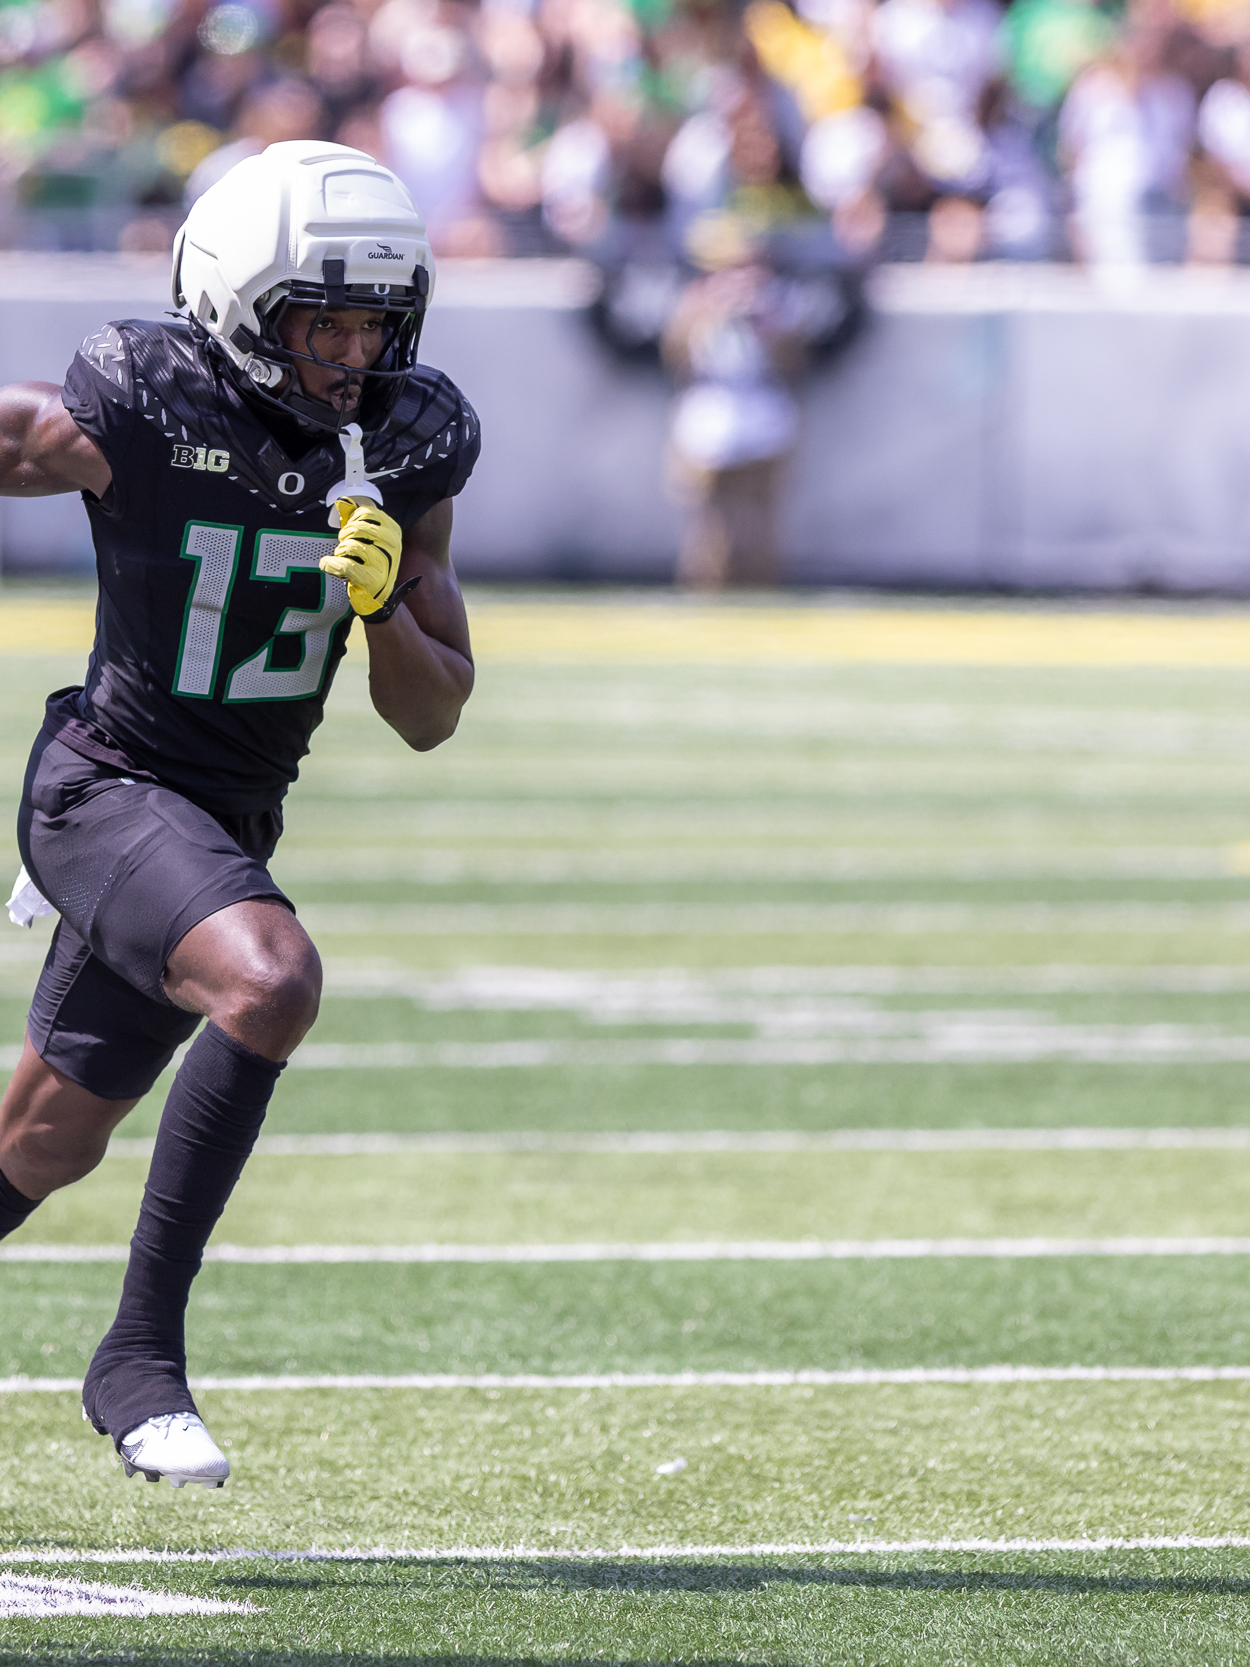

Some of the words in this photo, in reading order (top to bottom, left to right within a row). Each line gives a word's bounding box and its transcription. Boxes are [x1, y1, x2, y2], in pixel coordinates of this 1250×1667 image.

[368, 252, 404, 260] GUARDIAN
[277, 471, 305, 495] O
[171, 520, 352, 703] 13
